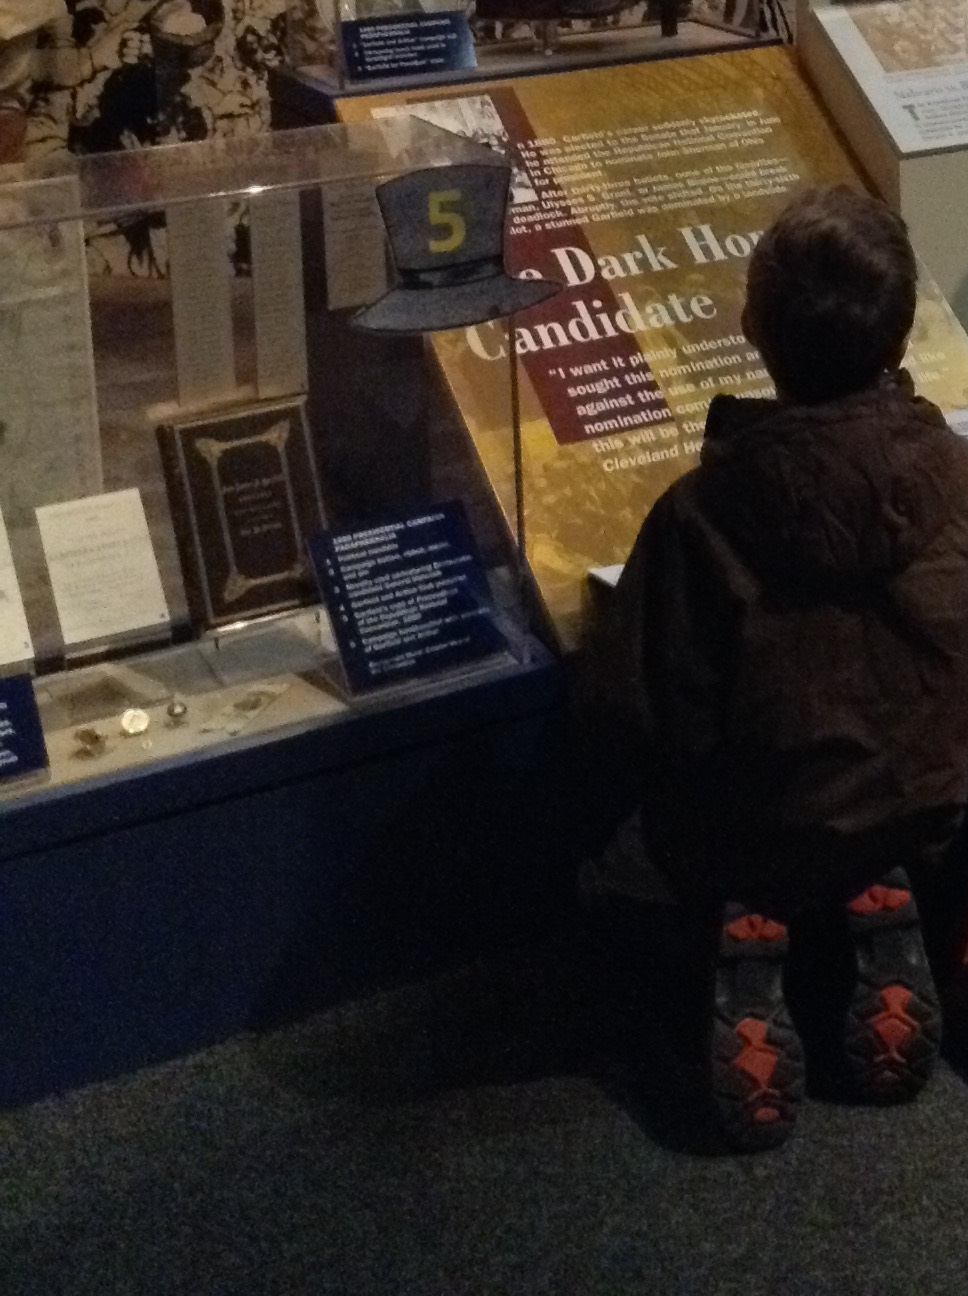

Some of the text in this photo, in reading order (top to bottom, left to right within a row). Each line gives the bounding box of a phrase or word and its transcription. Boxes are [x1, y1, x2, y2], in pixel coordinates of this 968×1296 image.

[429, 189, 466, 253] 5
[551, 223, 765, 287] Dark Hor
[466, 292, 718, 361] Candidate
[567, 376, 624, 402] sought
[625, 367, 656, 389] this
[658, 353, 744, 380] nomination
[570, 359, 609, 378] want
[612, 355, 626, 370] it
[629, 346, 679, 370] plainly
[683, 334, 748, 358] understo
[576, 392, 636, 418] against
[638, 388, 667, 406] the
[700, 375, 718, 391] of
[719, 371, 745, 388] my
[585, 406, 675, 437] nomination
[592, 434, 626, 455] this
[628, 426, 657, 447] will
[659, 421, 680, 439] be
[602, 443, 680, 474] Cleveland
